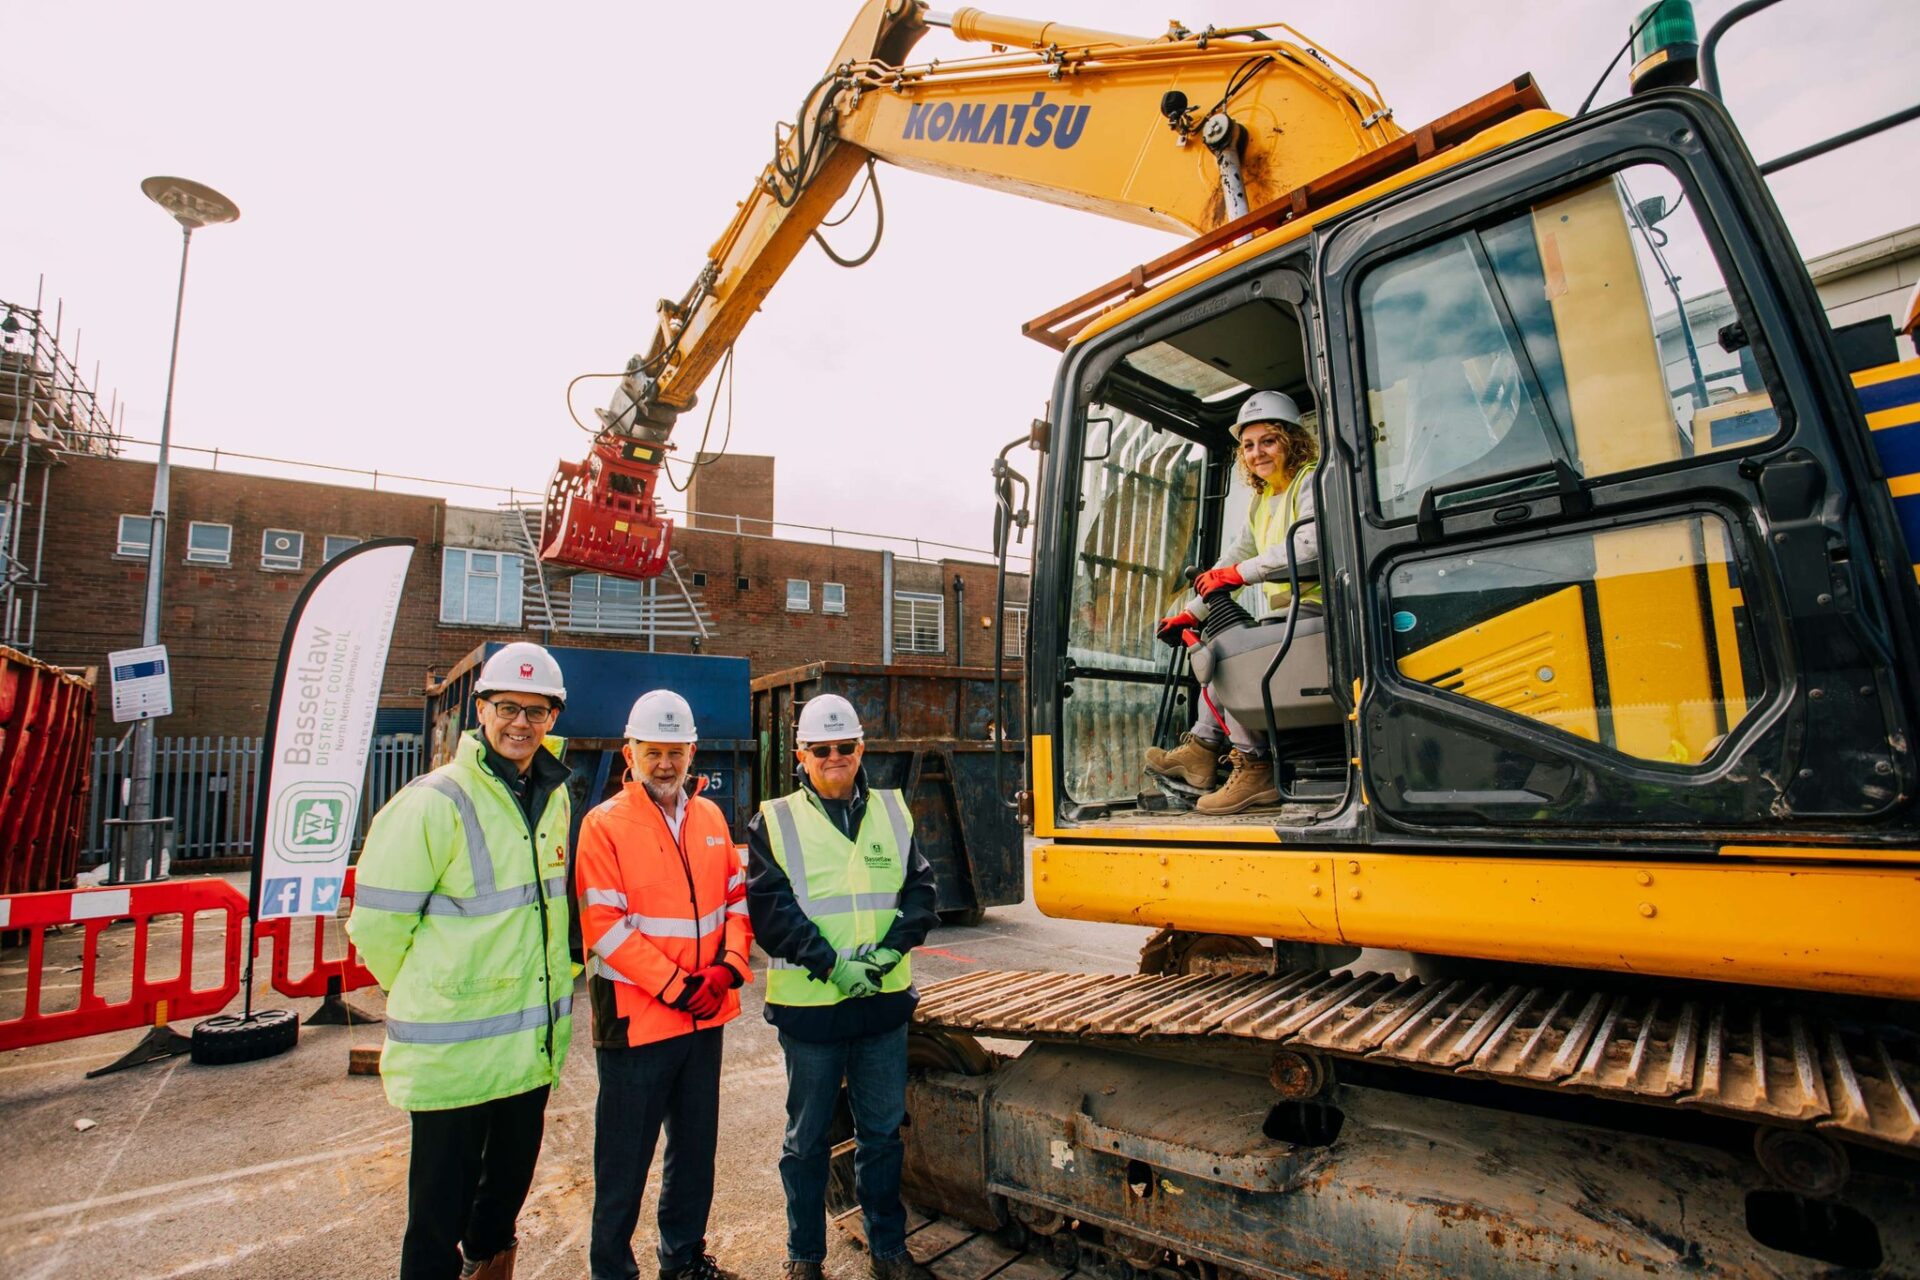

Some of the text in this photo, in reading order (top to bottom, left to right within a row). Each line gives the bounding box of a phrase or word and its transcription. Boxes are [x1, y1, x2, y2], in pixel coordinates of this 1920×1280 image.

[902, 91, 1091, 150] KOMATSU
[284, 626, 333, 766] Bassetlaw
[315, 629, 351, 767] DISTRICT COUNCIL
[334, 644, 362, 752] North Nottinghamshire
